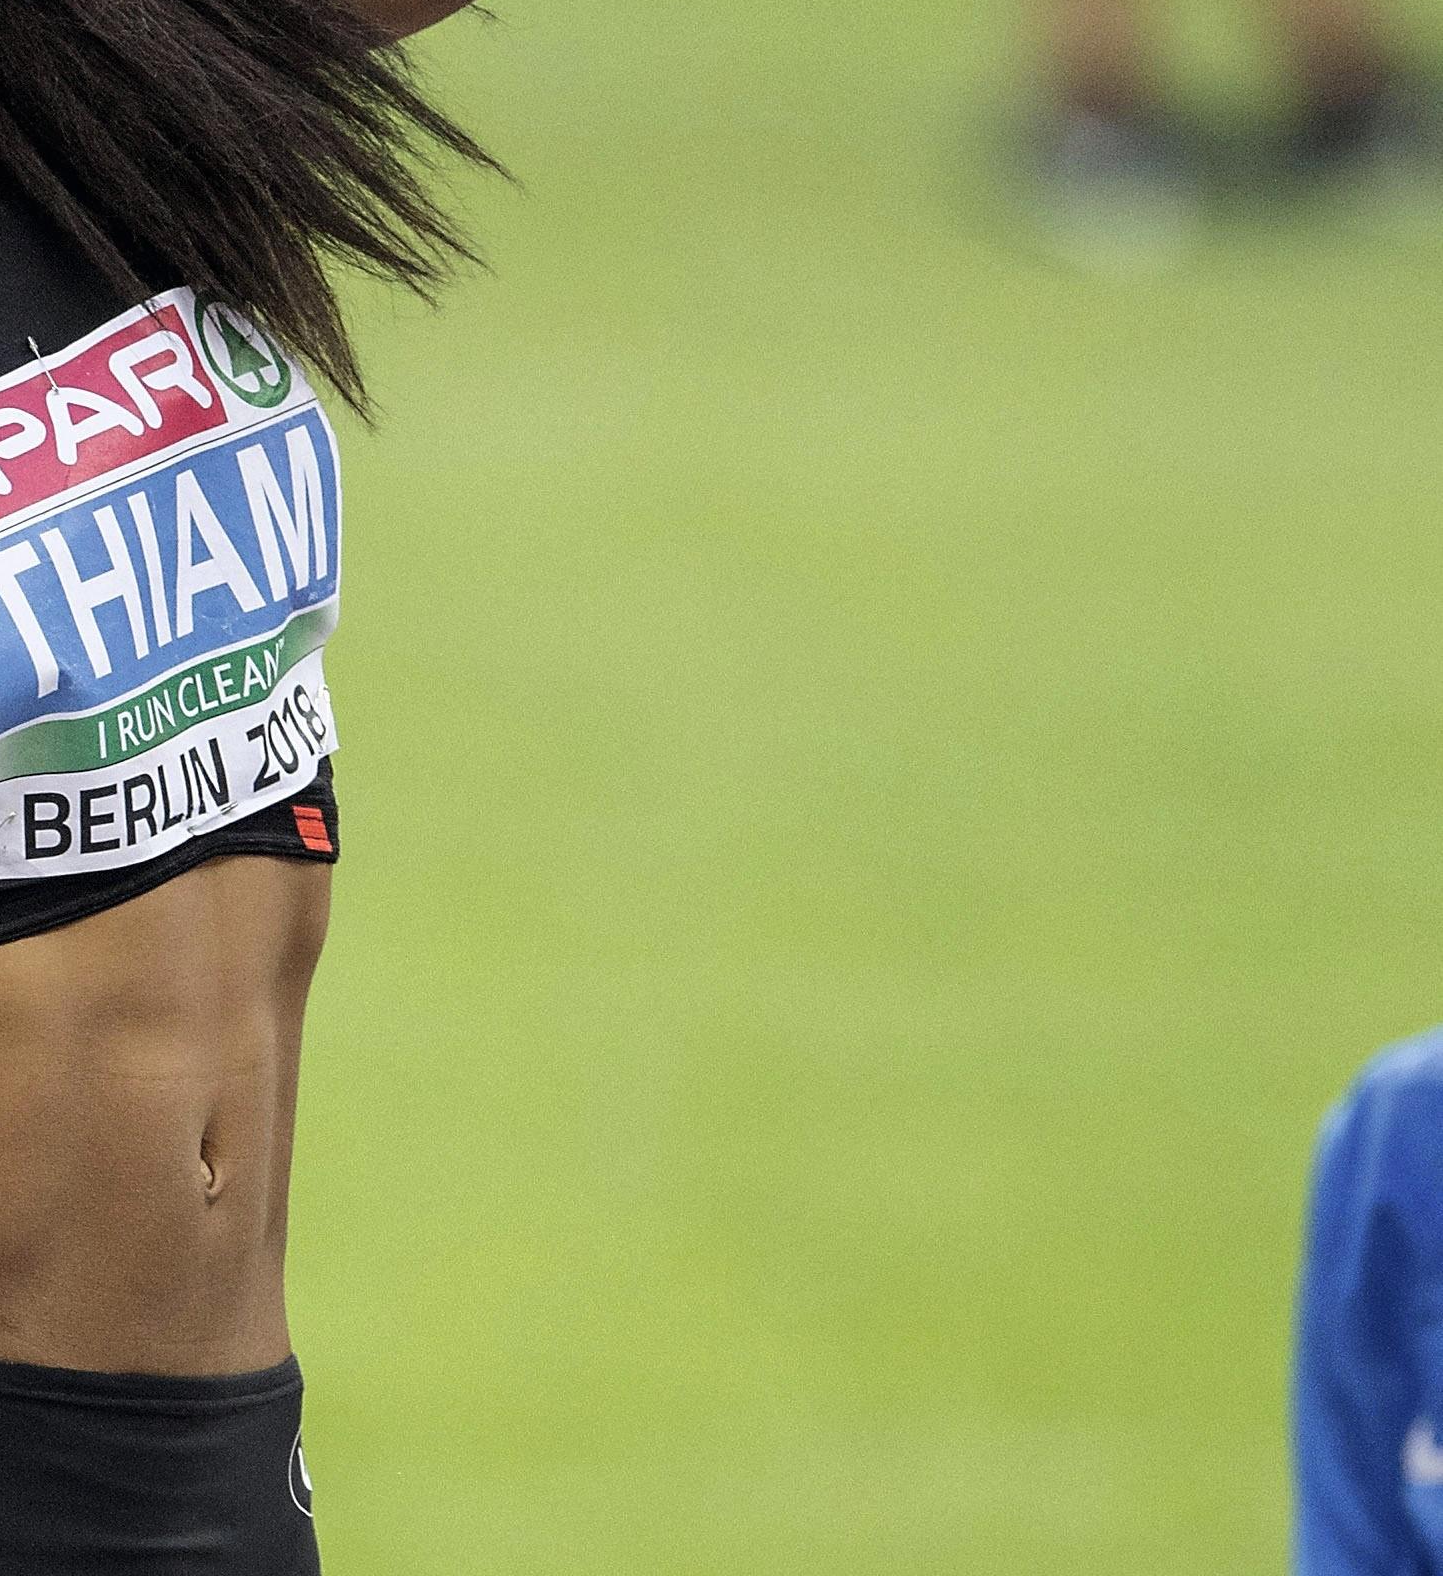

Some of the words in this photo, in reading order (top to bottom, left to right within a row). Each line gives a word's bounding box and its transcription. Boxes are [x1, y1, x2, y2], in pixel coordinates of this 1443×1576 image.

[23, 737, 229, 860] BERLIN
[246, 684, 326, 792] 2018
[98, 721, 107, 759] I
[118, 689, 176, 752] RUN
